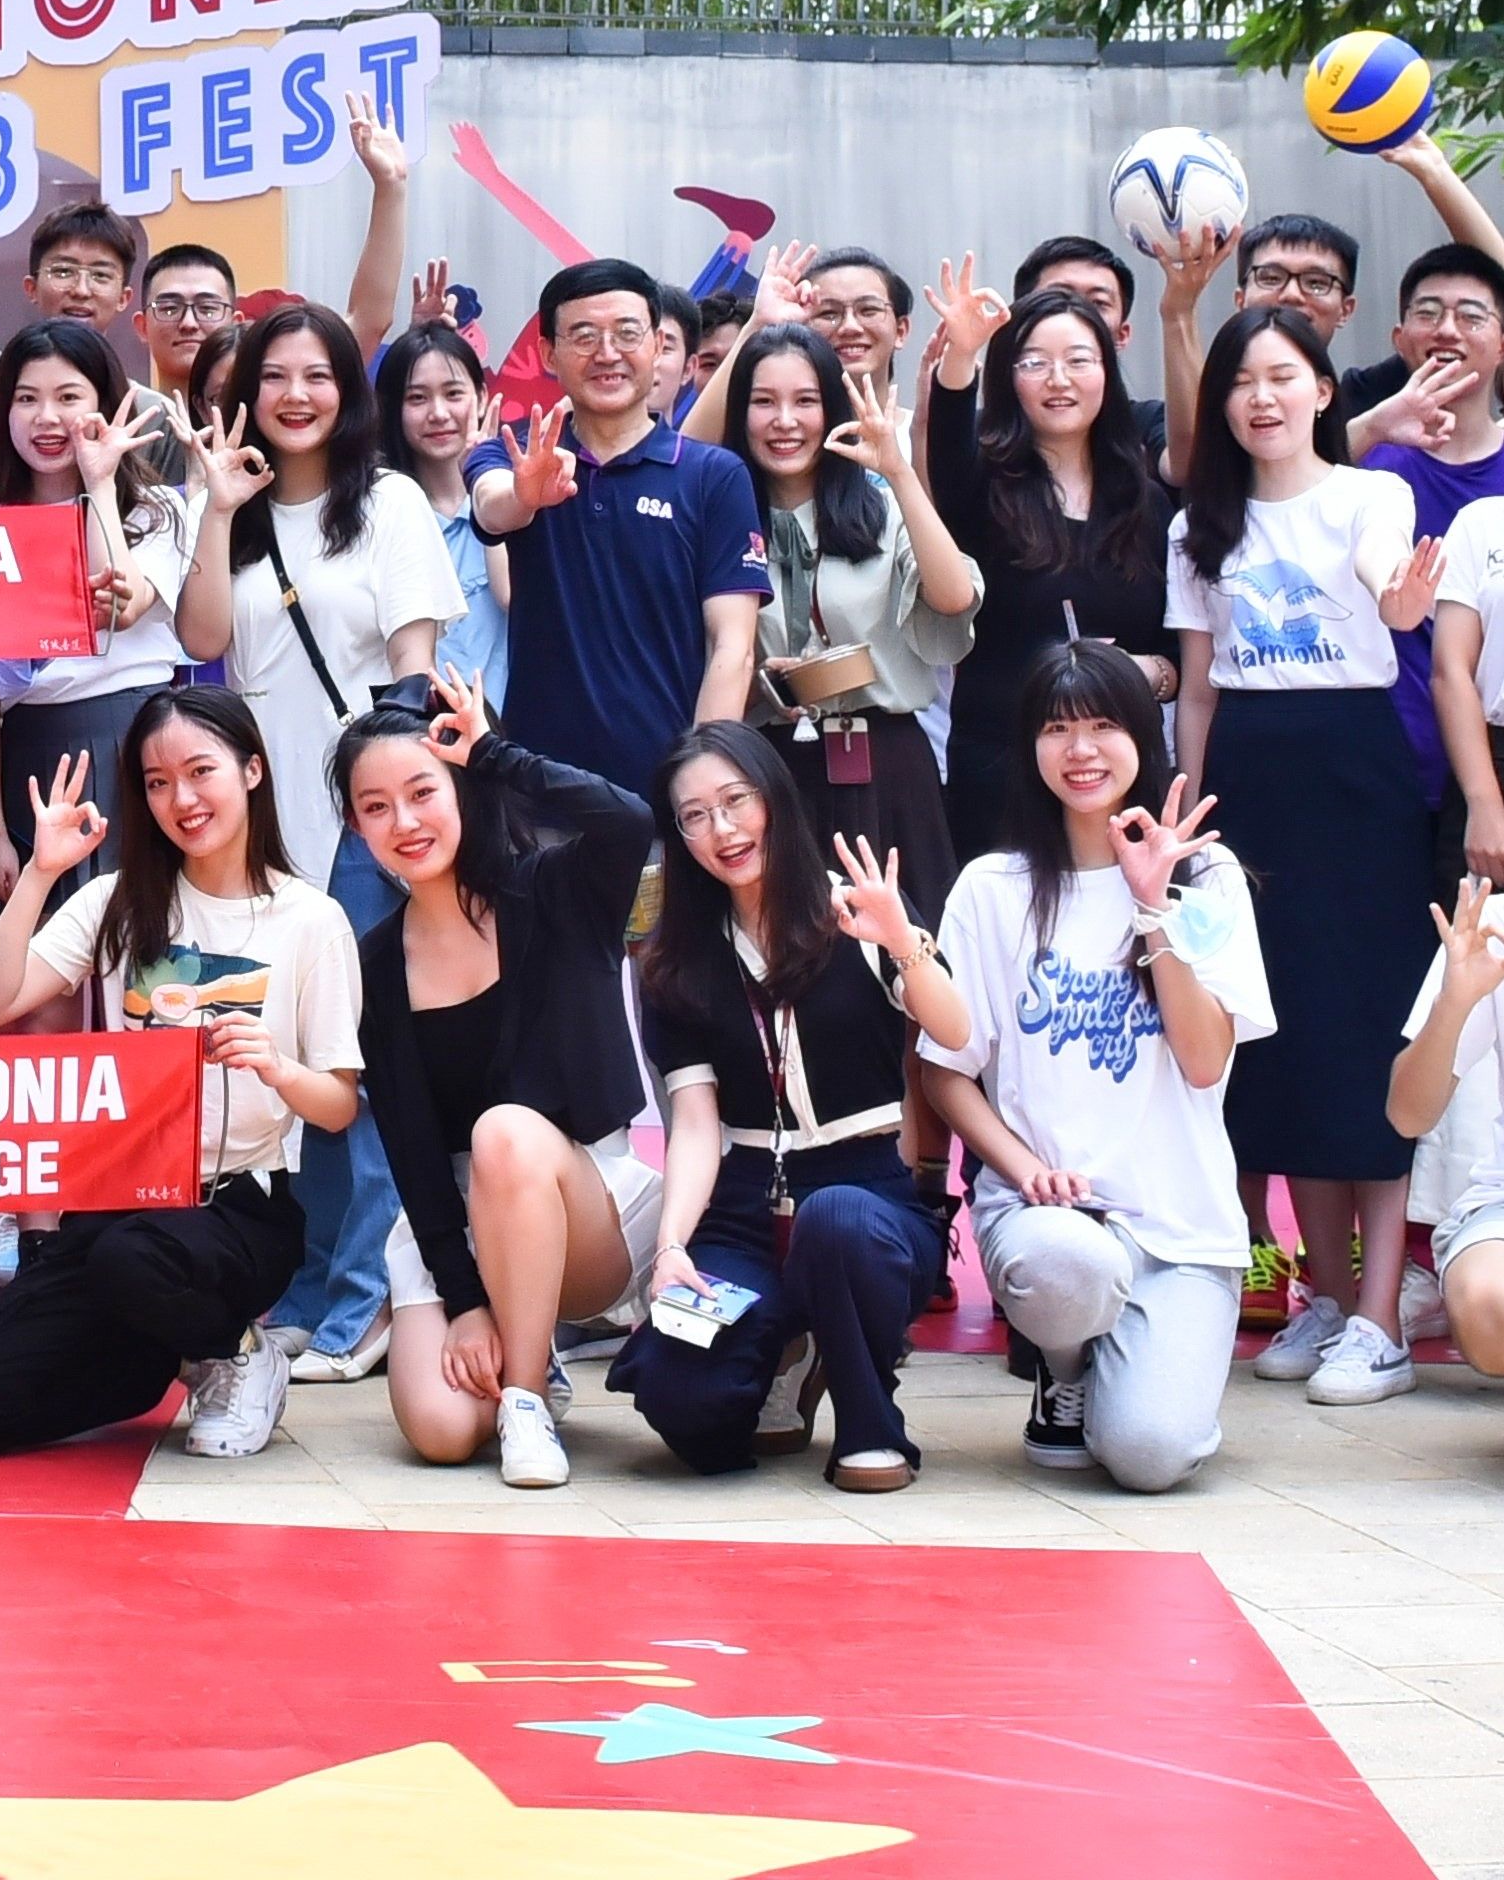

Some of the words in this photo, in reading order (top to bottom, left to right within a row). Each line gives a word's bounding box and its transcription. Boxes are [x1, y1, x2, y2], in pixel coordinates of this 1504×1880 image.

[122, 35, 418, 195] FEST
[635, 495, 674, 520] OSA
[1016, 948, 1140, 1034] Strong
